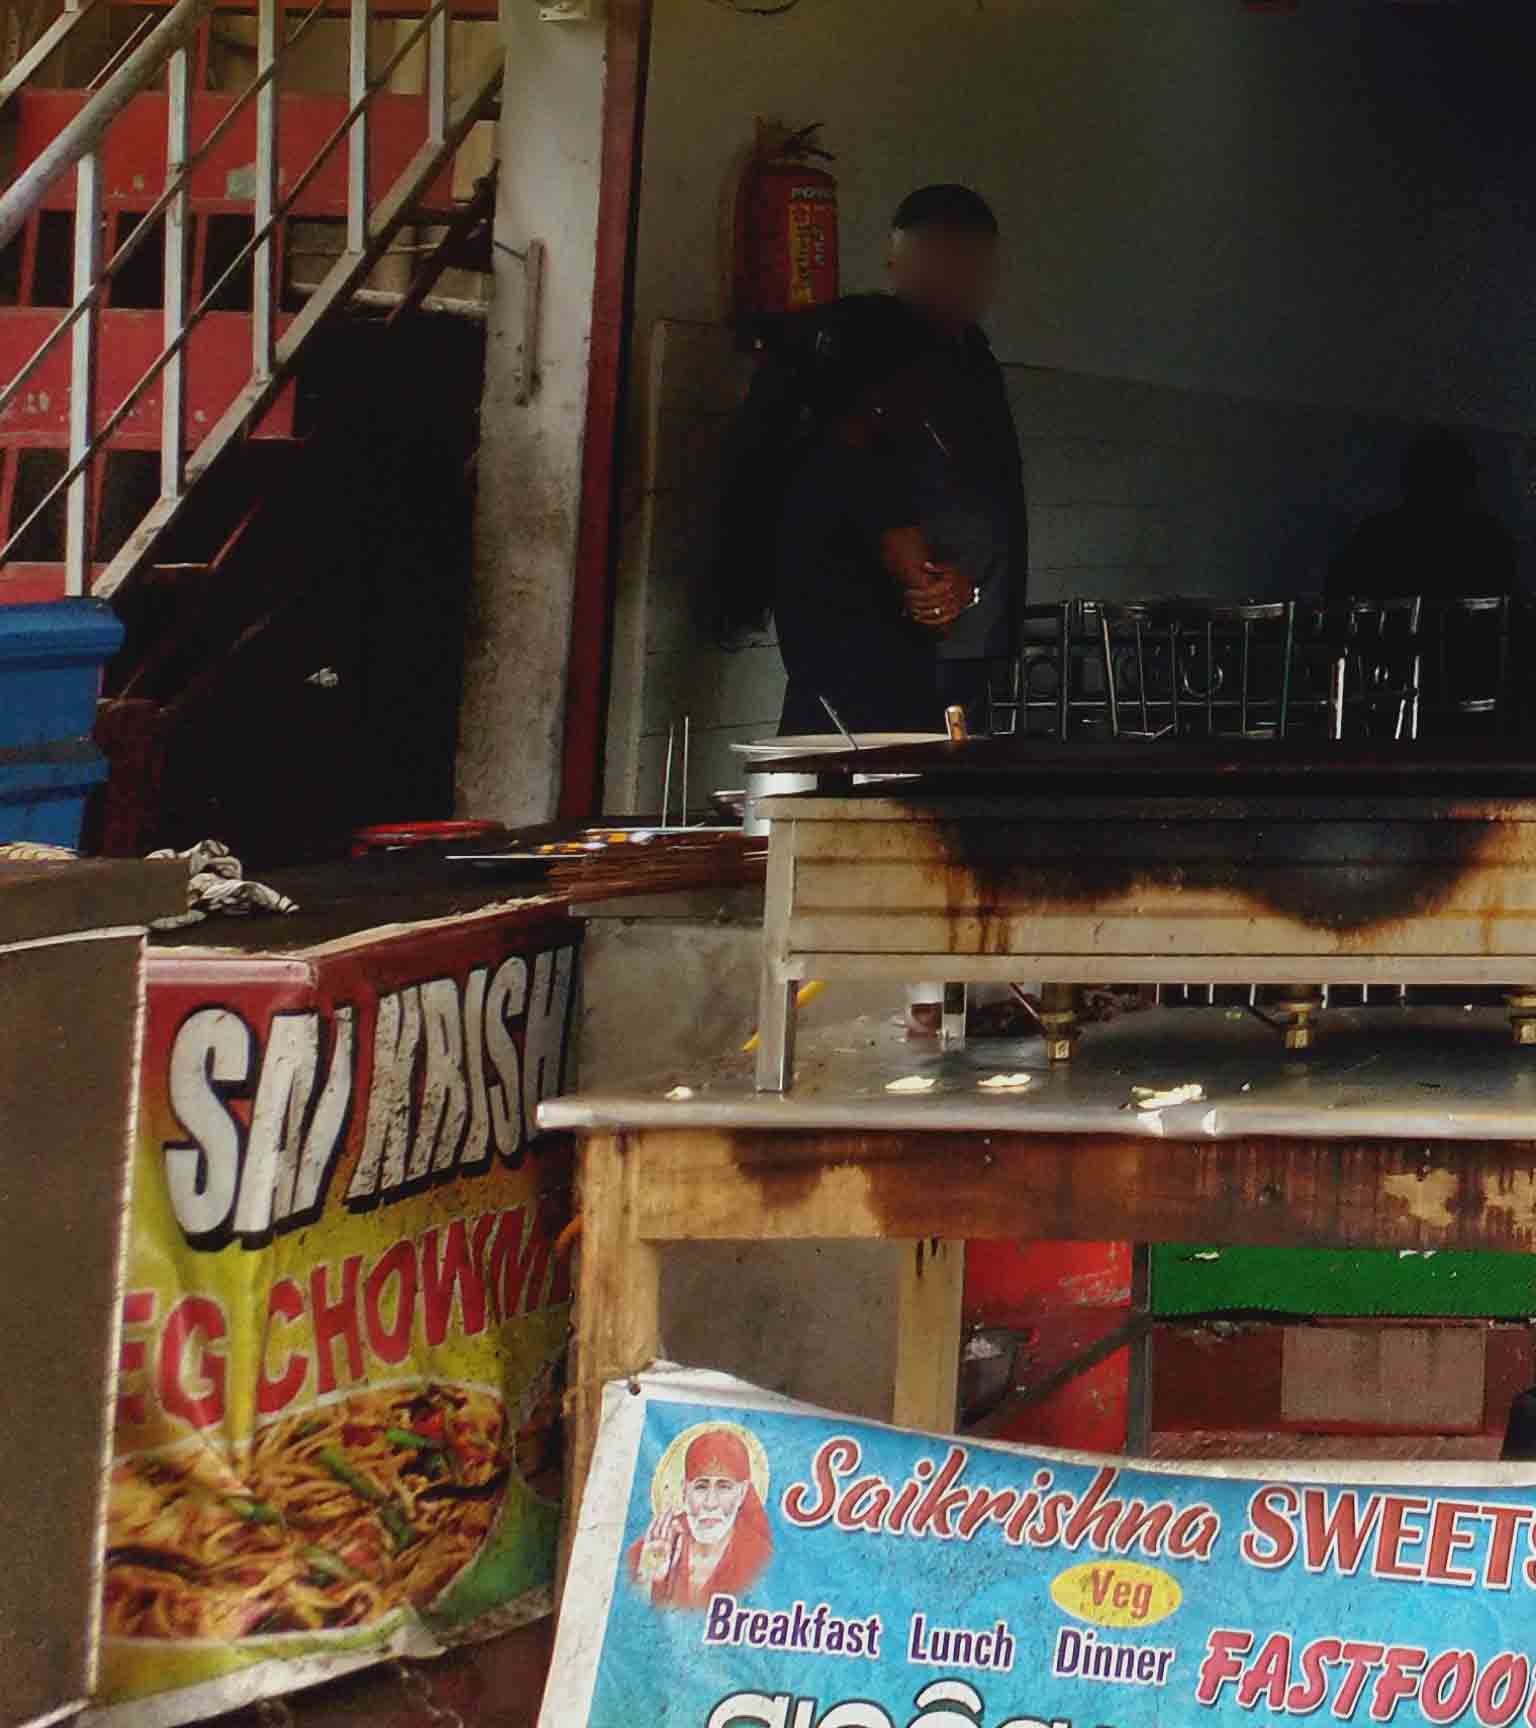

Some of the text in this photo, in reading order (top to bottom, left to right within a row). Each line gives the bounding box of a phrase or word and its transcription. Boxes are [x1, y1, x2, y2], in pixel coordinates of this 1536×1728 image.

[164, 1006, 353, 1240] SAI
[784, 1435, 1219, 1557] Saikrishna
[708, 1597, 880, 1656] Breakfast
[911, 1615, 1016, 1670] Lunch
[1056, 1628, 1175, 1683] Dinner
[1091, 1567, 1154, 1619] Veg
